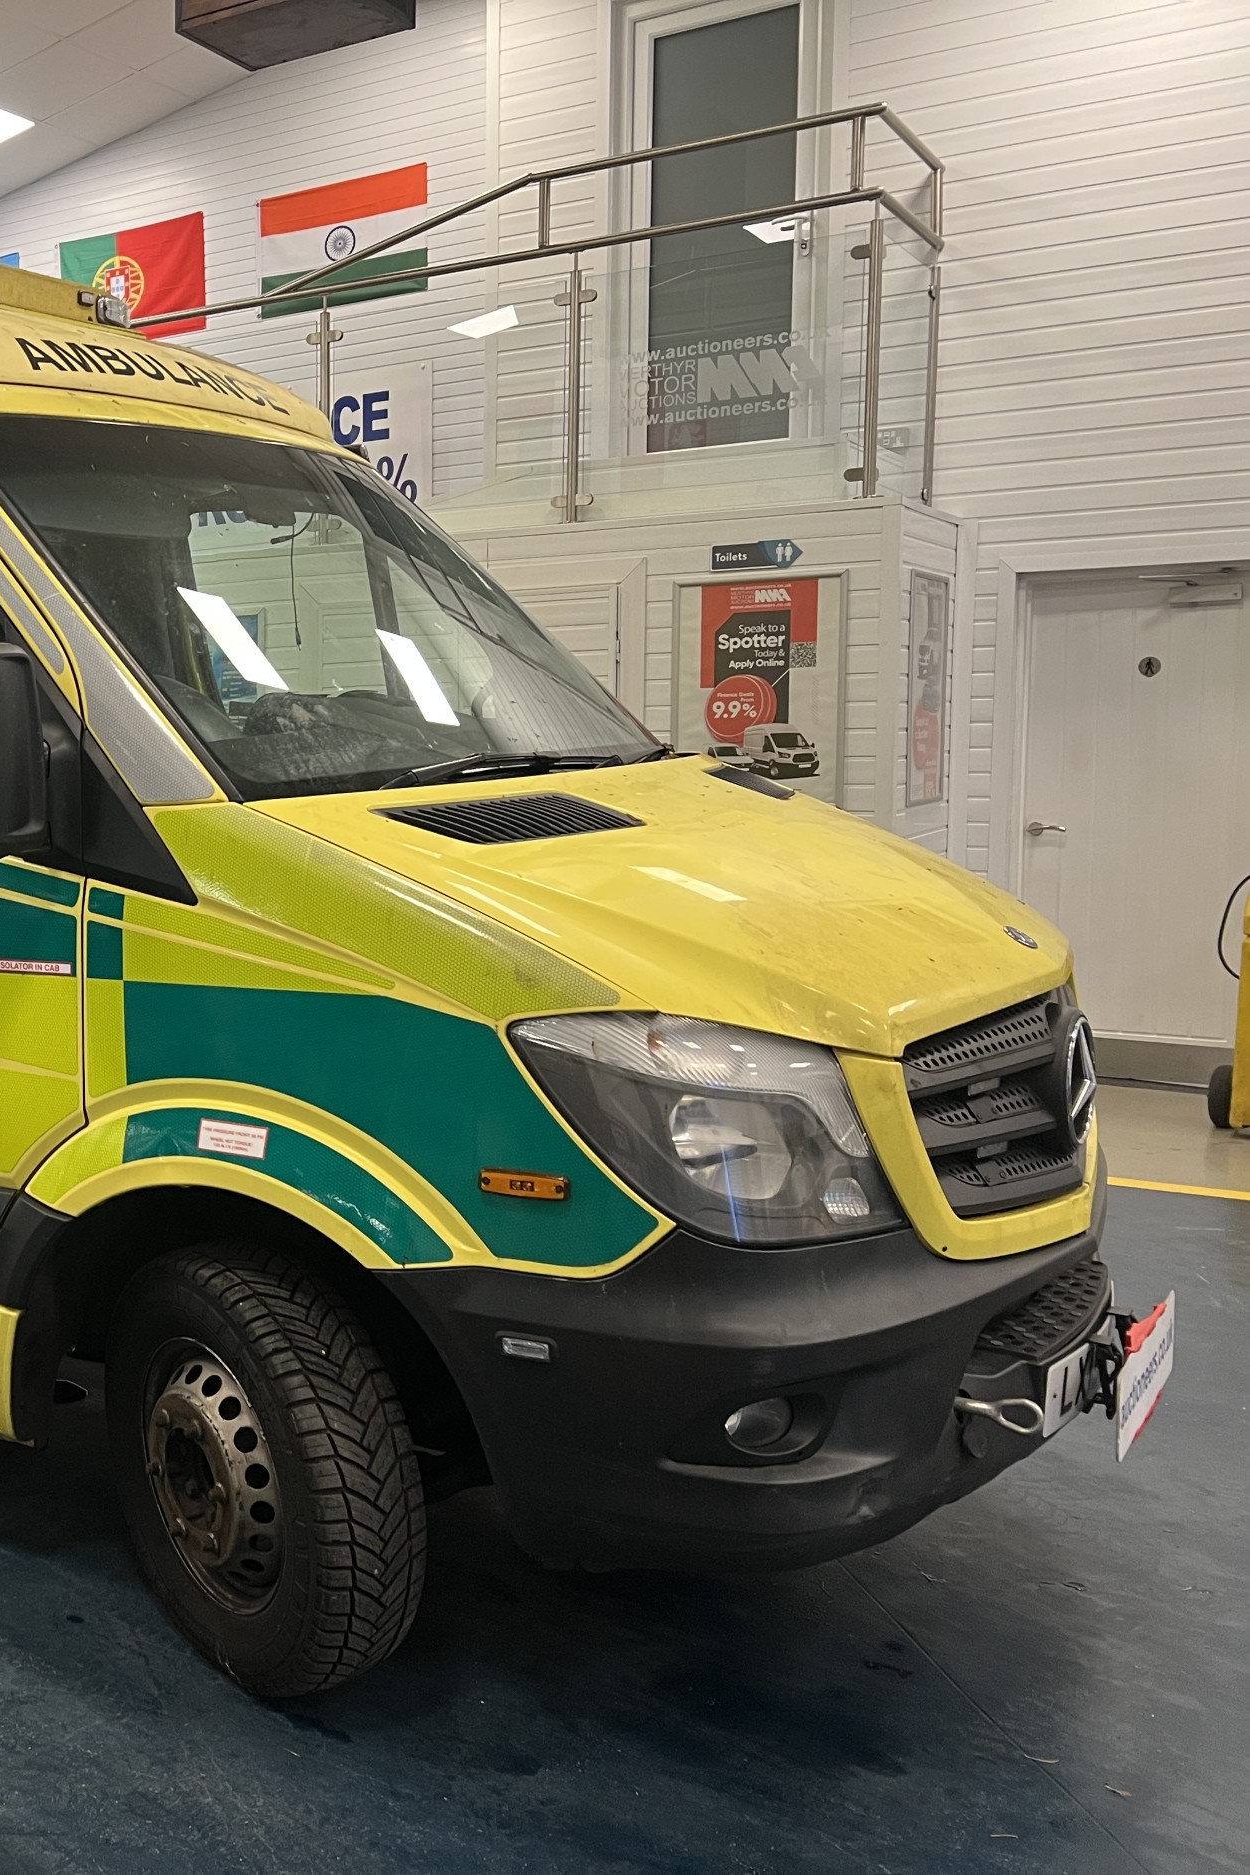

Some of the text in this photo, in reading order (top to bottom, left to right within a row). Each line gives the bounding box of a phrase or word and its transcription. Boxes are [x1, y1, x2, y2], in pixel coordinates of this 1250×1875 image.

[15, 337, 290, 416] AMBULANCE
[715, 552, 747, 562] Toilets
[739, 623, 786, 635] Speak to a
[718, 634, 785, 653] Spotter
[754, 649, 785, 658] Today &
[728, 659, 785, 670] Apply Online
[712, 700, 757, 719] 9.9%
[44, 964, 60, 972] CAB
